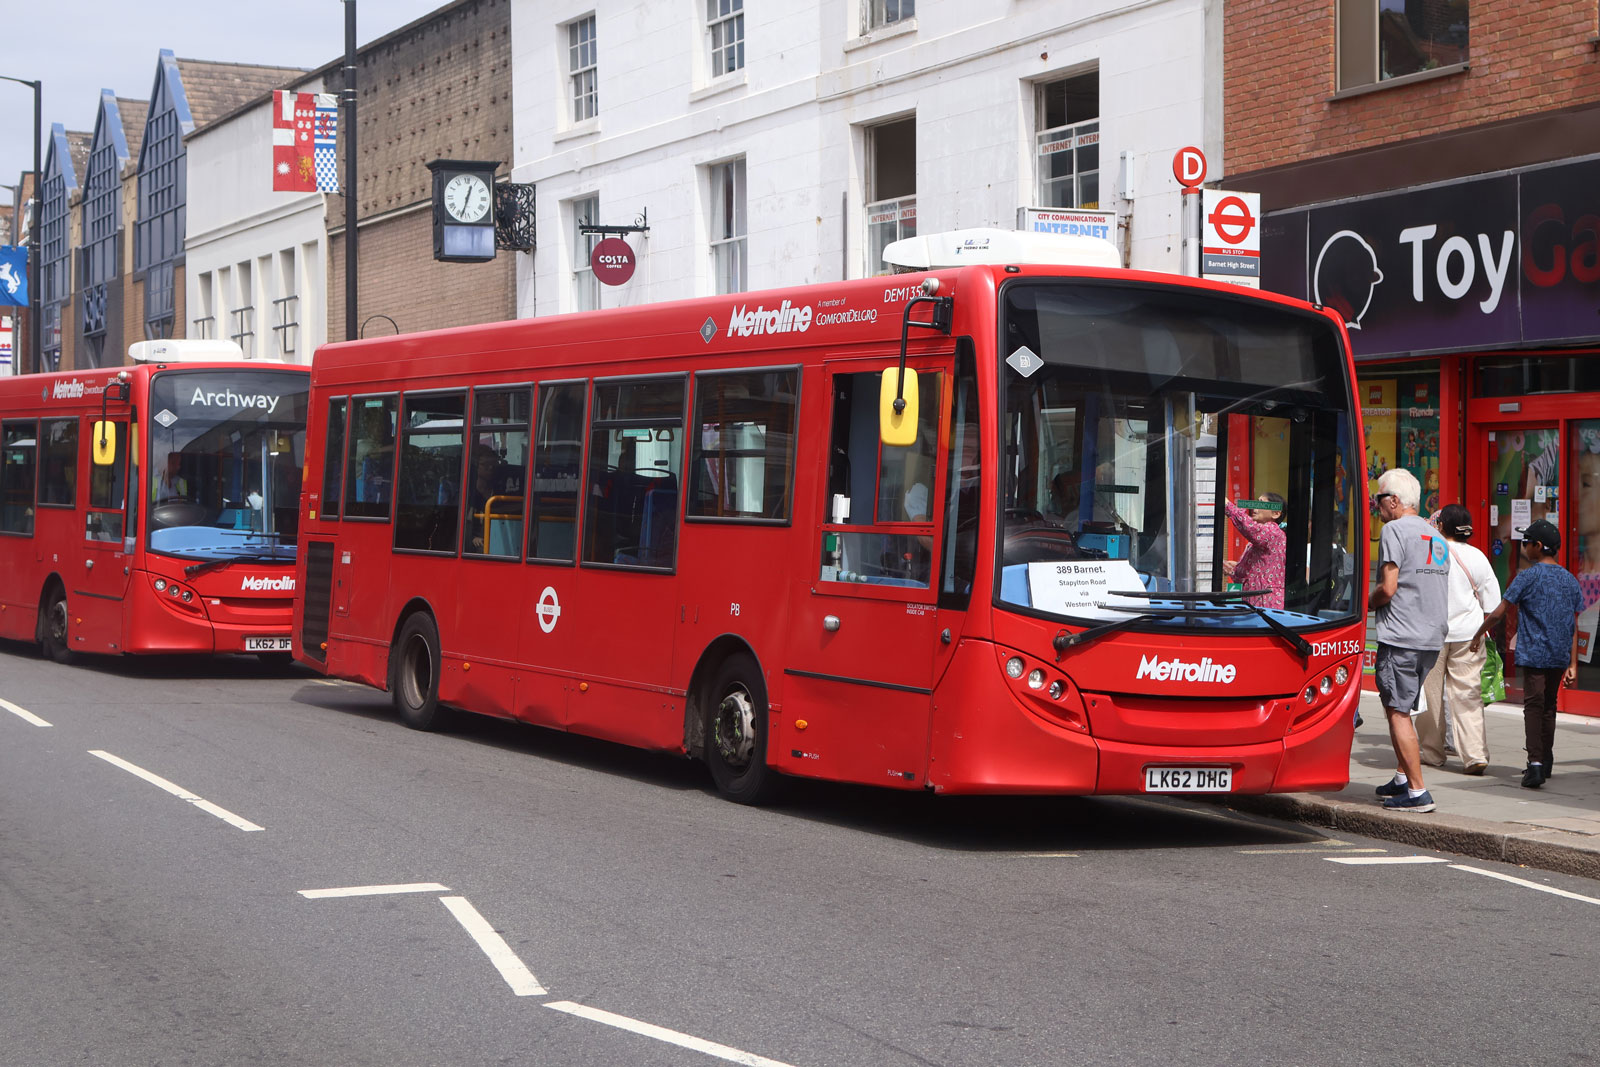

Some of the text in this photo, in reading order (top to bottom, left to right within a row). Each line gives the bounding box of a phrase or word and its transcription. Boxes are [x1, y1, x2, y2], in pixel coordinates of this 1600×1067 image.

[1042, 139, 1072, 154] INTERNET
[1183, 152, 1203, 180] D
[871, 212, 896, 223] INTERNET
[1038, 213, 1106, 223] CITY COMMUNICATIONS
[1034, 222, 1109, 239] INTERNET
[599, 255, 628, 264] COSTA
[1208, 260, 1226, 268] Barnet
[1227, 261, 1239, 269] High
[1399, 223, 1515, 314] Toy
[822, 298, 840, 307] member
[727, 300, 812, 337] Metroline
[53, 378, 84, 399] Metroline
[191, 387, 279, 413] Archway
[1056, 565, 1106, 574] 389 Barnet.
[1059, 579, 1089, 587] Stapylton
[730, 602, 740, 616] PB
[249, 639, 275, 649] LK62
[1313, 640, 1359, 657] DEM1356
[1136, 654, 1237, 684] Metroline
[808, 752, 819, 760] PUSH
[887, 769, 898, 777] PUSH
[1149, 770, 1228, 788] LK62 DHG
